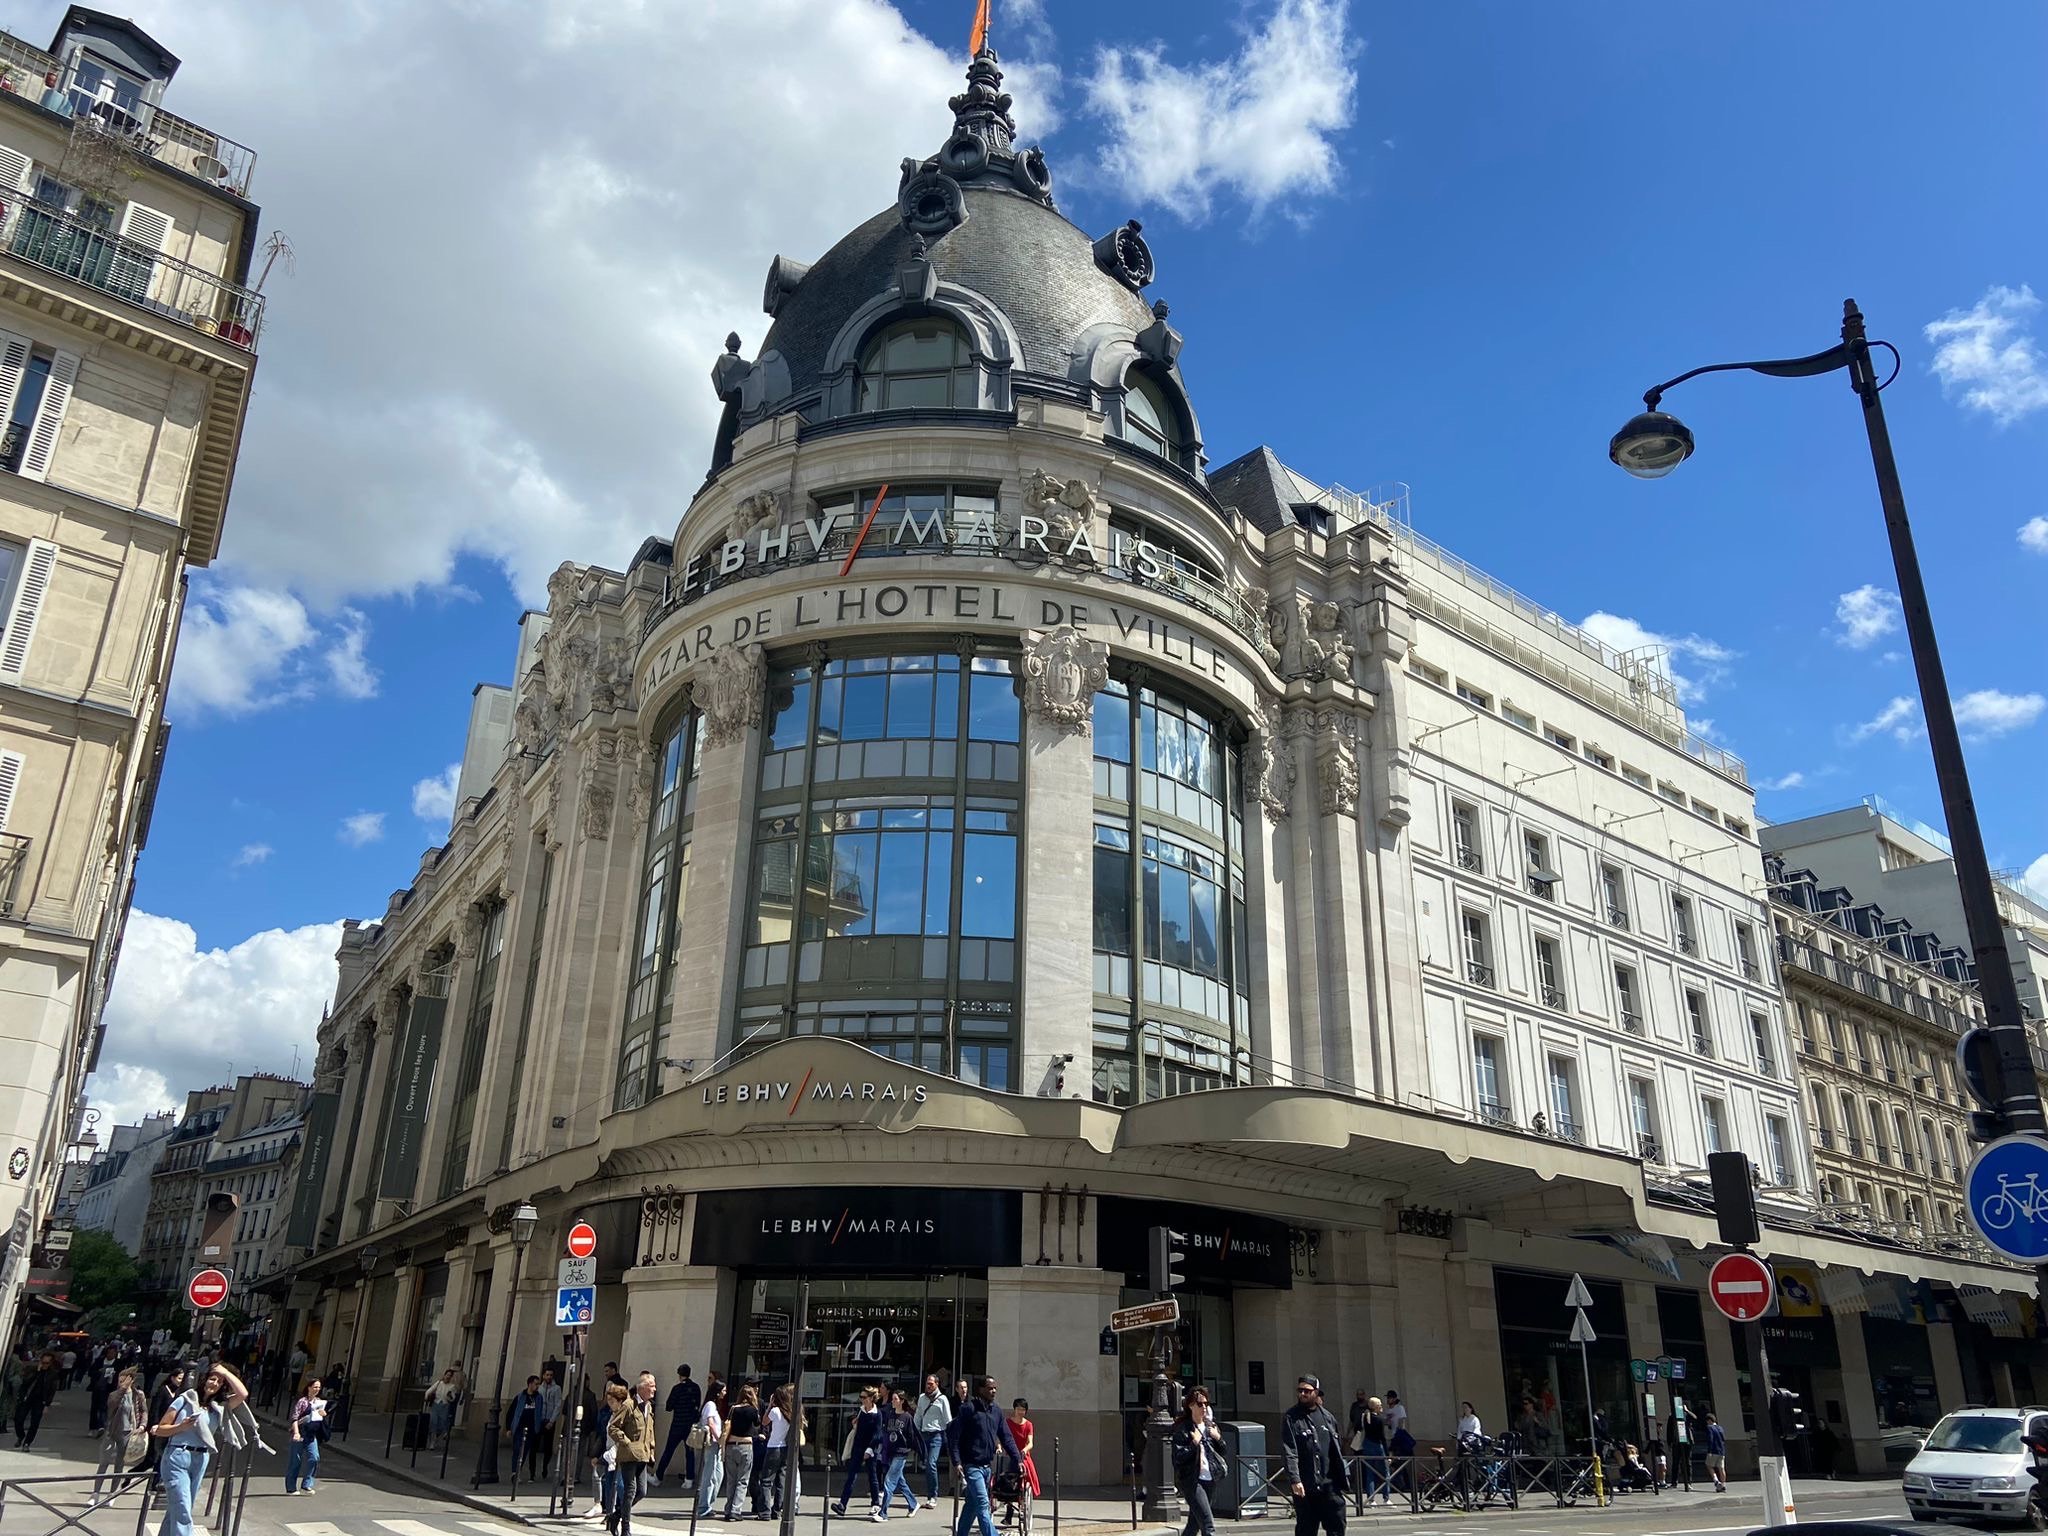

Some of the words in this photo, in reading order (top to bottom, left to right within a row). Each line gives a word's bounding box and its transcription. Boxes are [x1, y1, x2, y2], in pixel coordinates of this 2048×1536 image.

[663, 553, 702, 608] LE
[734, 608, 771, 642] DE
[795, 585, 1015, 628] L'HOTEL
[1042, 601, 1088, 631] DE
[1110, 608, 1226, 682] VILLE
[418, 1034, 427, 1054] jours
[415, 1053, 423, 1065] les
[411, 1065, 420, 1083] tous
[405, 1085, 418, 1112] Ouvert
[703, 1085, 728, 1105] LE
[761, 1219, 783, 1233] LE
[568, 1259, 587, 1268] SAUF
